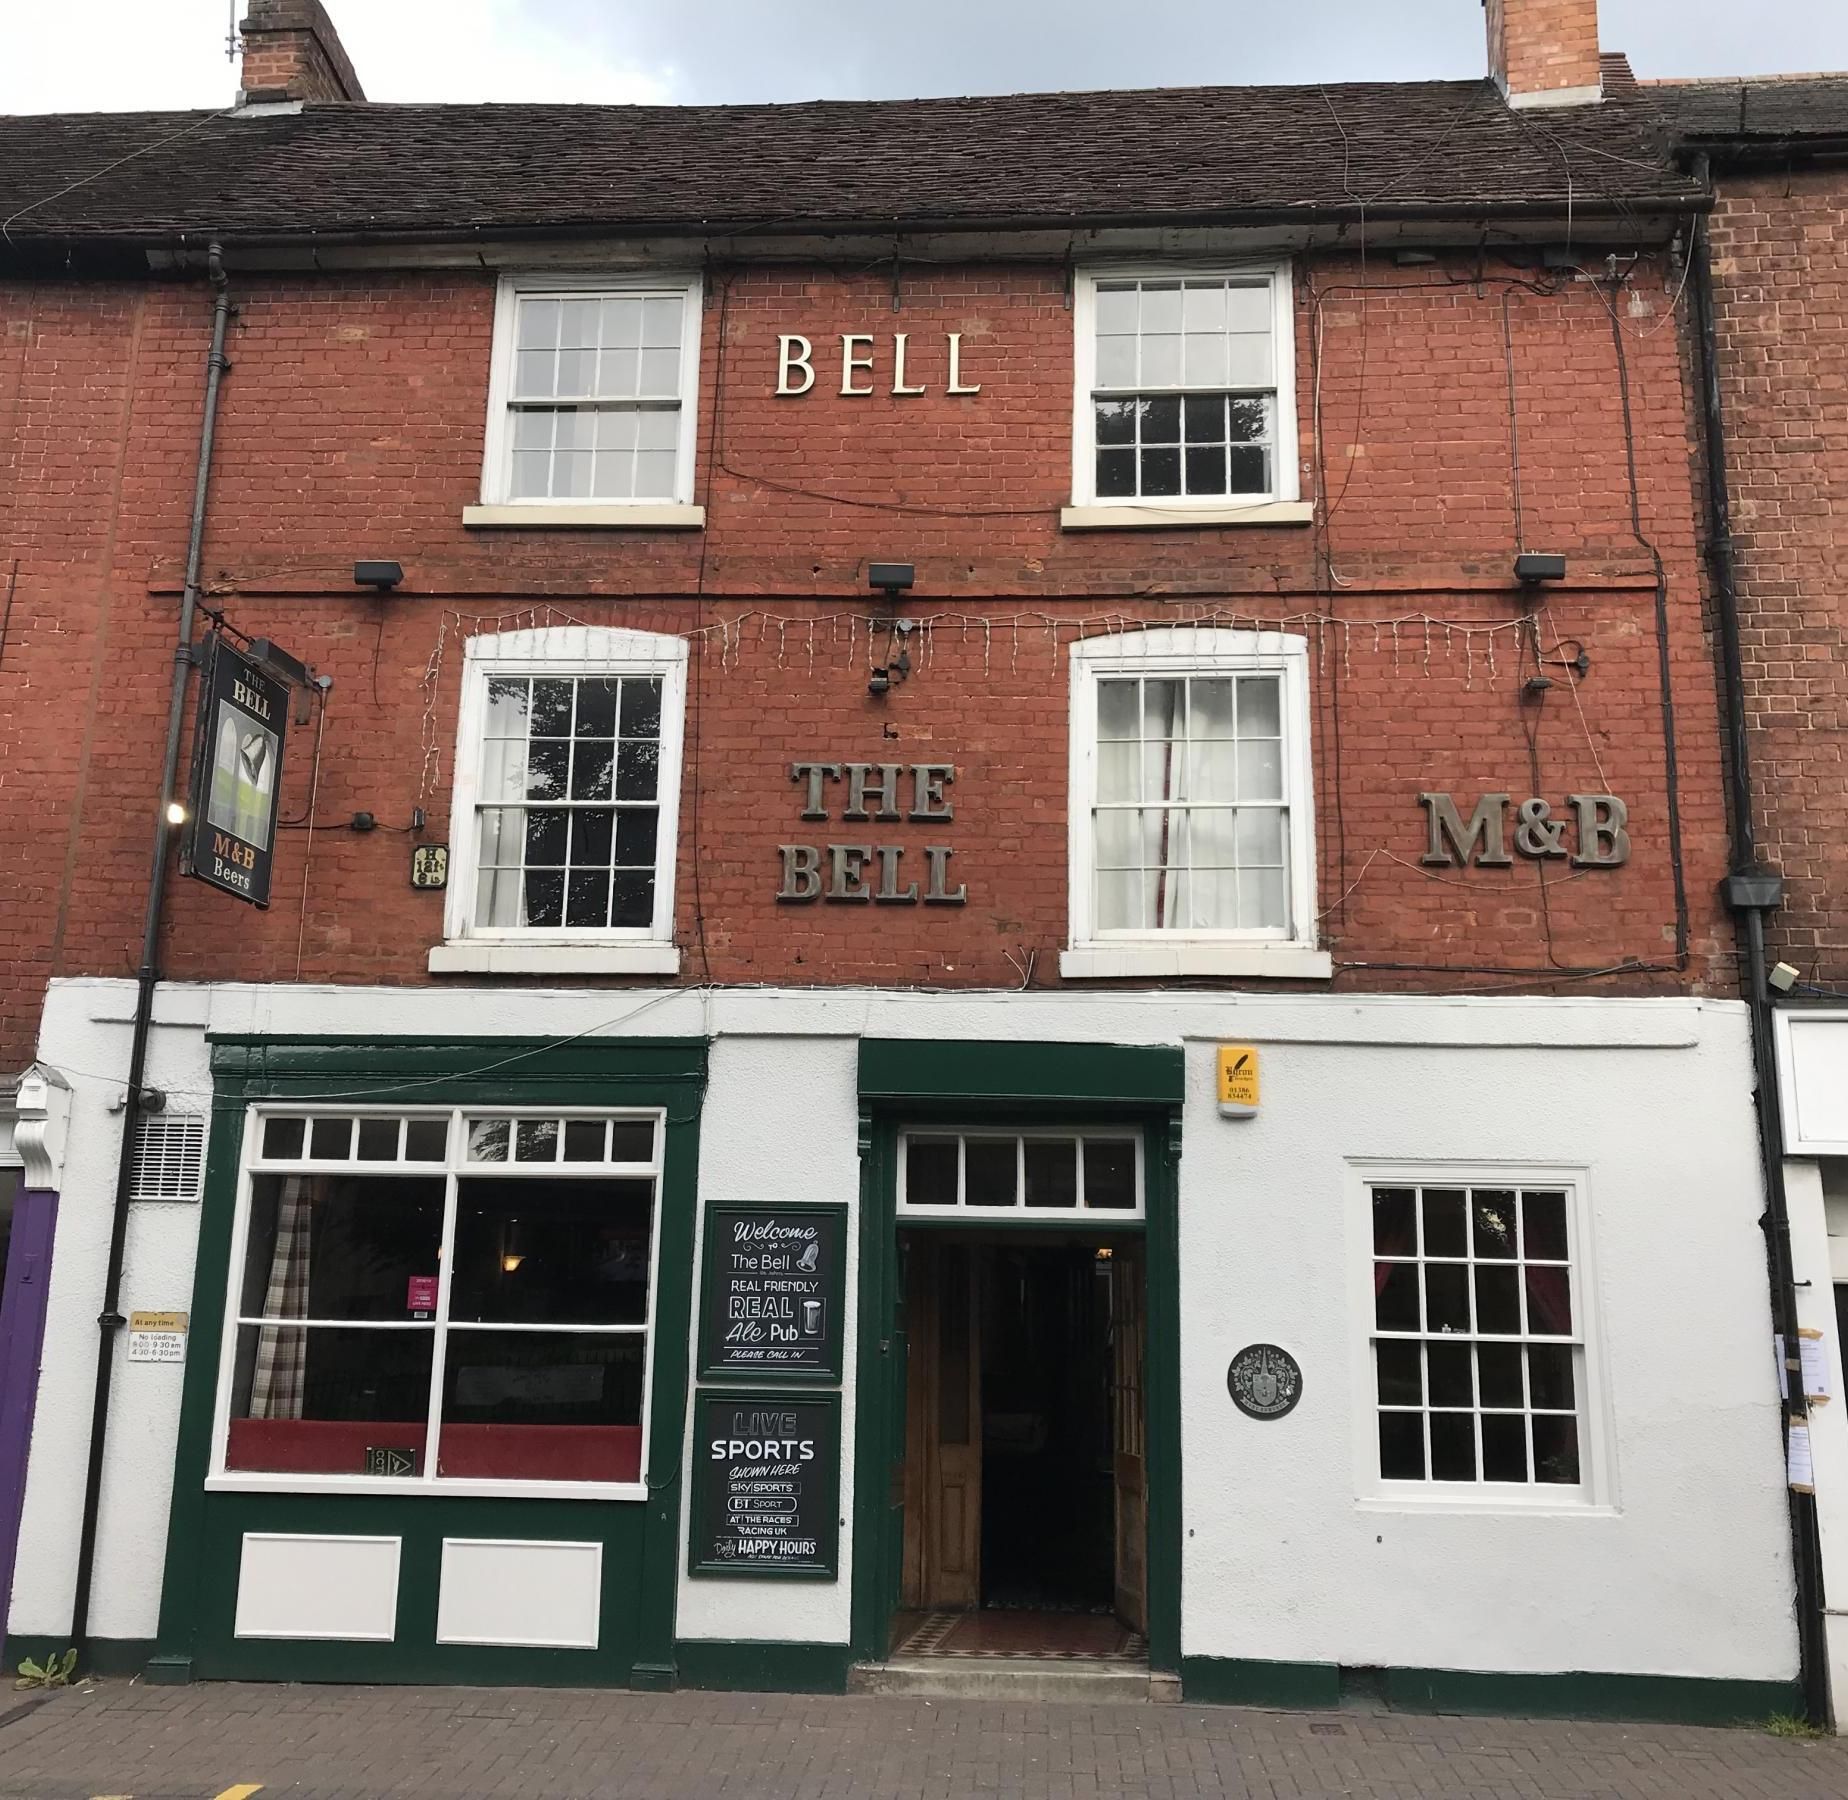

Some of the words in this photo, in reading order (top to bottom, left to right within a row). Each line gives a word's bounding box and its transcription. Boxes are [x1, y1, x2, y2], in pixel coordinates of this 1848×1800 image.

[774, 333, 982, 396] BELL
[244, 668, 265, 692] THE
[232, 678, 271, 720] BELL
[791, 763, 954, 821] THE
[1418, 792, 1631, 868] M&B
[212, 832, 255, 870] M&B
[213, 857, 250, 890] Beers
[775, 844, 967, 905] BELL
[734, 1220, 818, 1242] Welcome
[768, 1242, 778, 1250] TO
[731, 1253, 758, 1269] The
[761, 1254, 790, 1270] Bell
[731, 1280, 761, 1292] REAL
[764, 1280, 819, 1293] FRIENDLY
[729, 1296, 793, 1318] REAL
[150, 1334, 177, 1342] loading
[725, 1321, 767, 1342] Ale
[770, 1323, 799, 1342] Pub
[730, 1350, 765, 1359] PLEASE
[766, 1350, 789, 1359] CALL
[790, 1350, 805, 1359] IN
[733, 1412, 797, 1436] LIVE
[711, 1440, 815, 1460] SPORTS
[728, 1465, 771, 1480] SHOWN
[769, 1463, 803, 1477] HERE
[753, 1483, 794, 1492] SPORTS
[734, 1499, 751, 1509] BT
[729, 1516, 740, 1524] AT
[745, 1516, 762, 1524] THE
[762, 1516, 793, 1524] RACES
[737, 1527, 774, 1536] RACING
[774, 1527, 787, 1536] UK
[713, 1540, 737, 1559] Daily
[738, 1539, 778, 1554] HAPPY
[779, 1541, 817, 1555] HOURS
